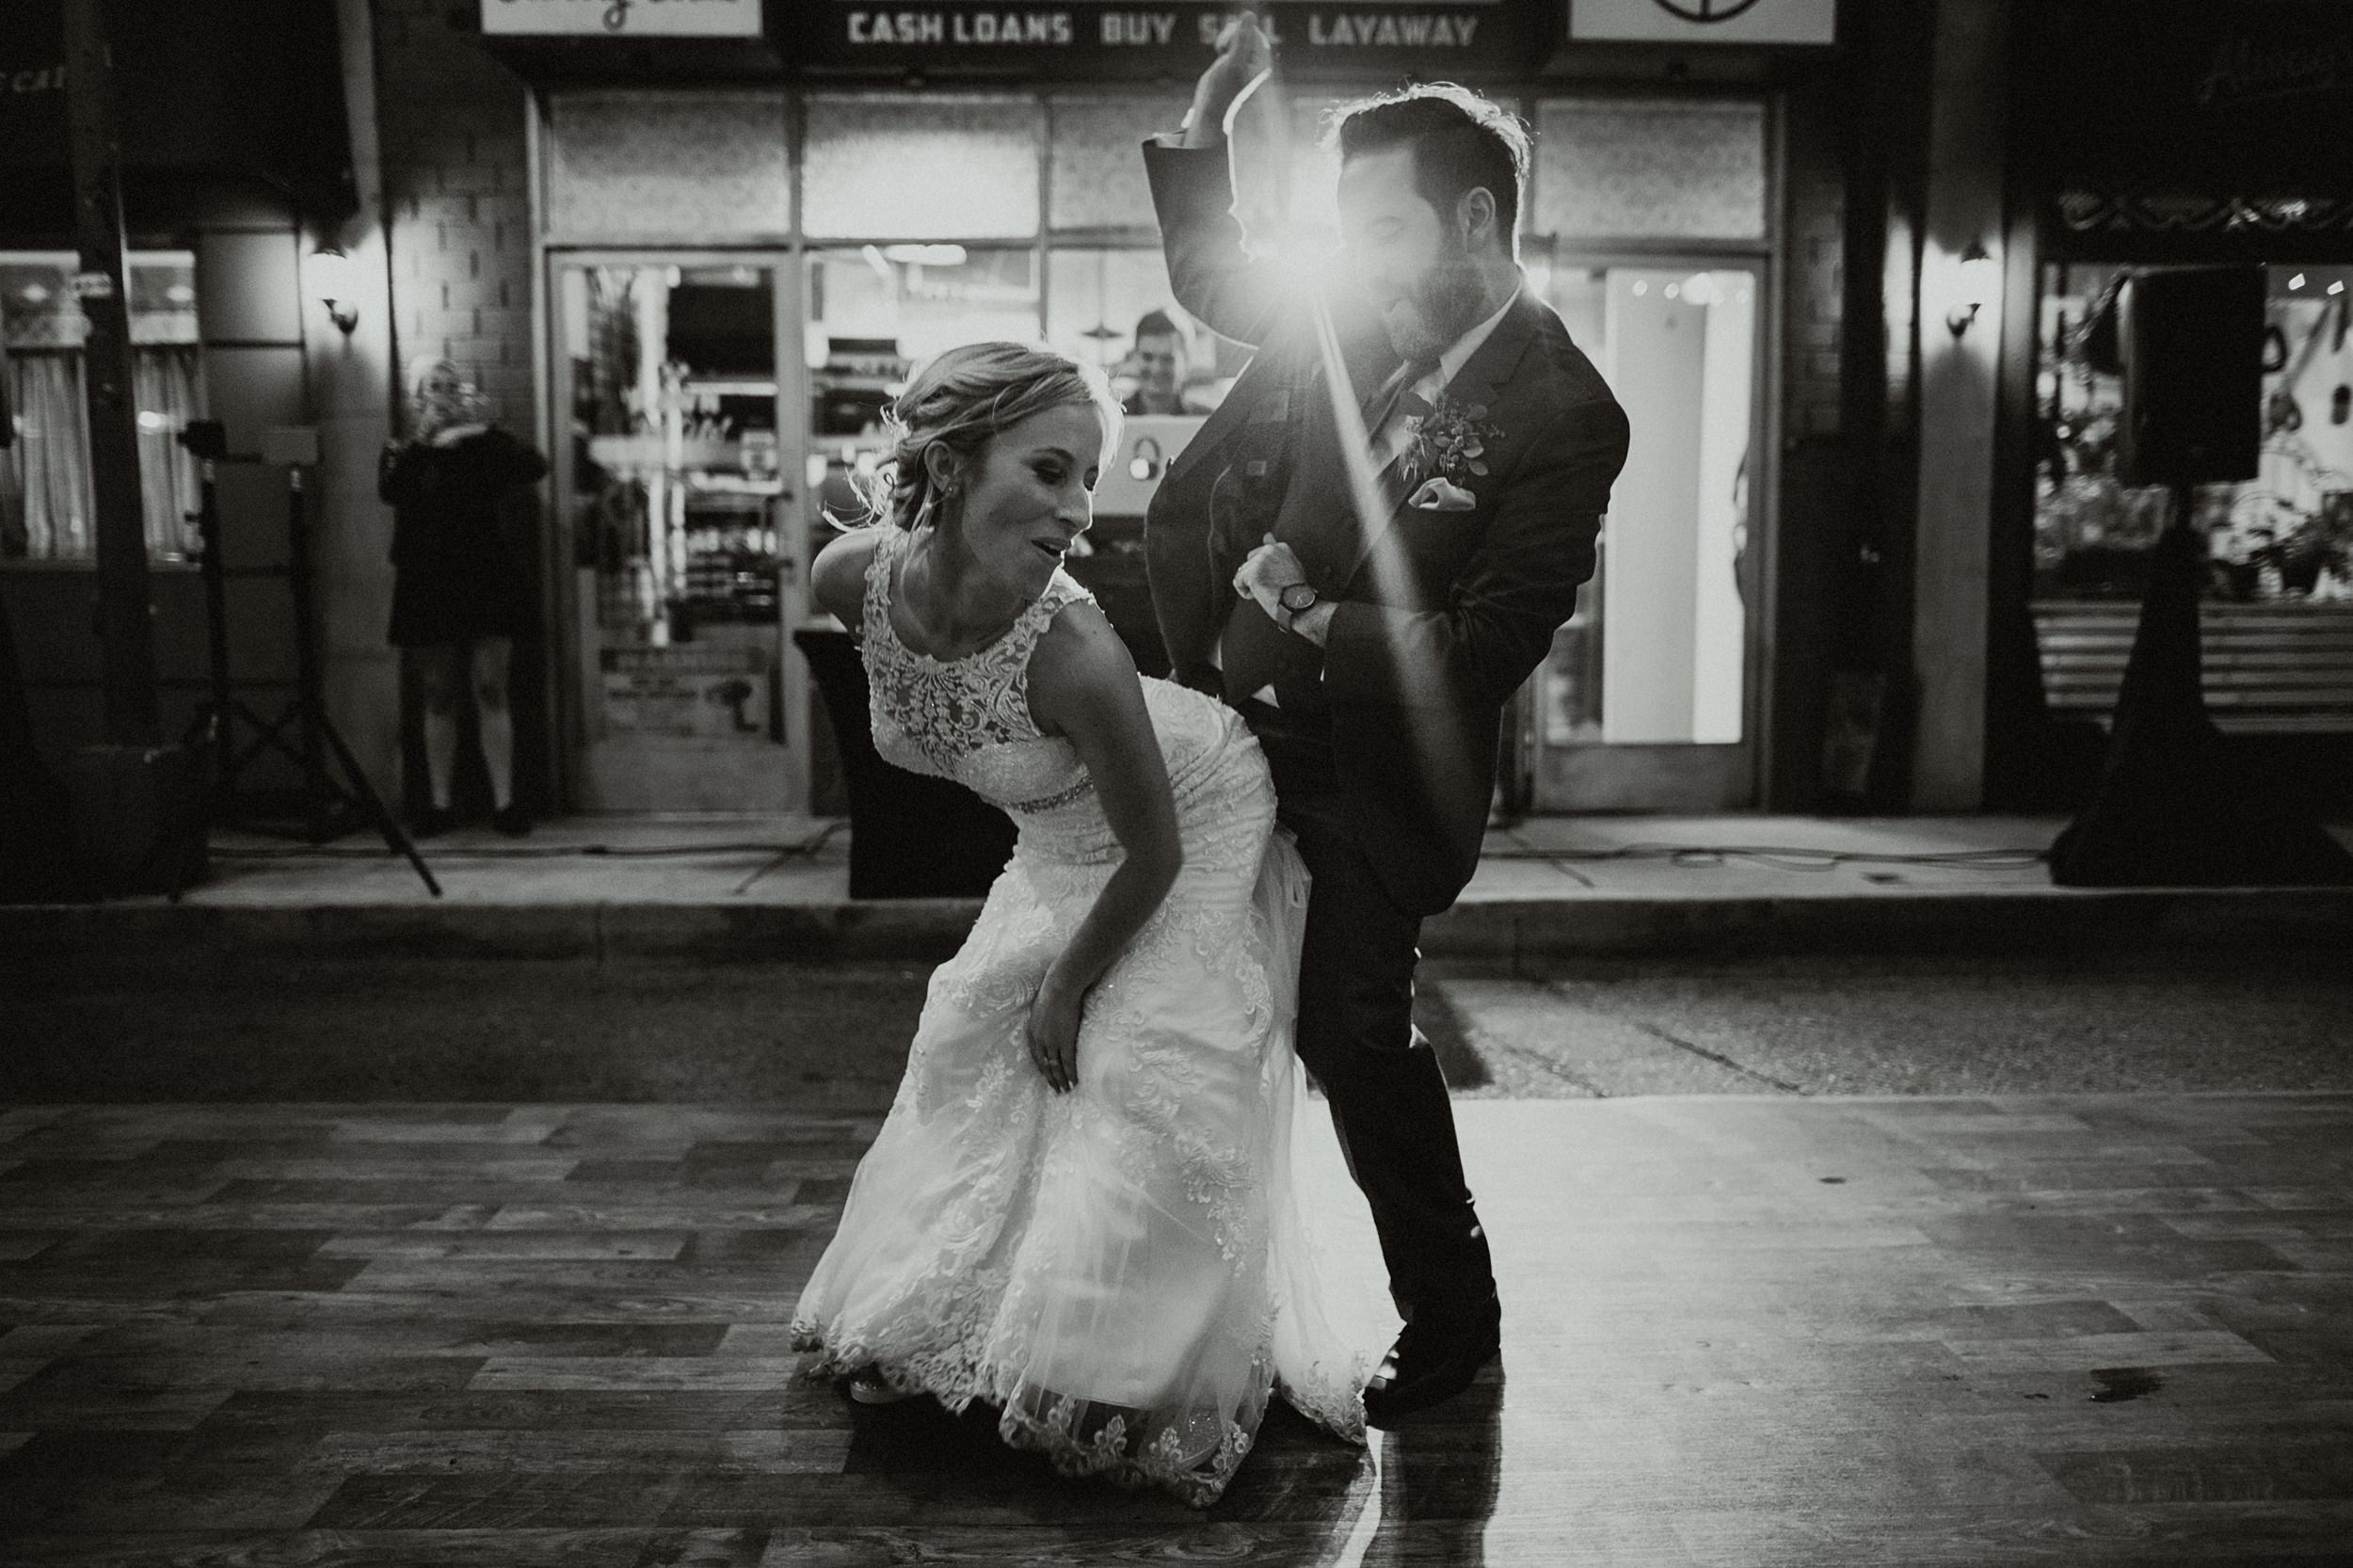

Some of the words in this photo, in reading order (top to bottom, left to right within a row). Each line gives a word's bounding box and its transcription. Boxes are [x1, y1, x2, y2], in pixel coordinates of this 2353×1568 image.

[848, 12, 943, 43] CASH
[952, 12, 1072, 43] LOANS
[1099, 13, 1176, 44] BUY
[1198, 14, 1282, 45] SL
[1308, 14, 1478, 45] LAYAWAY
